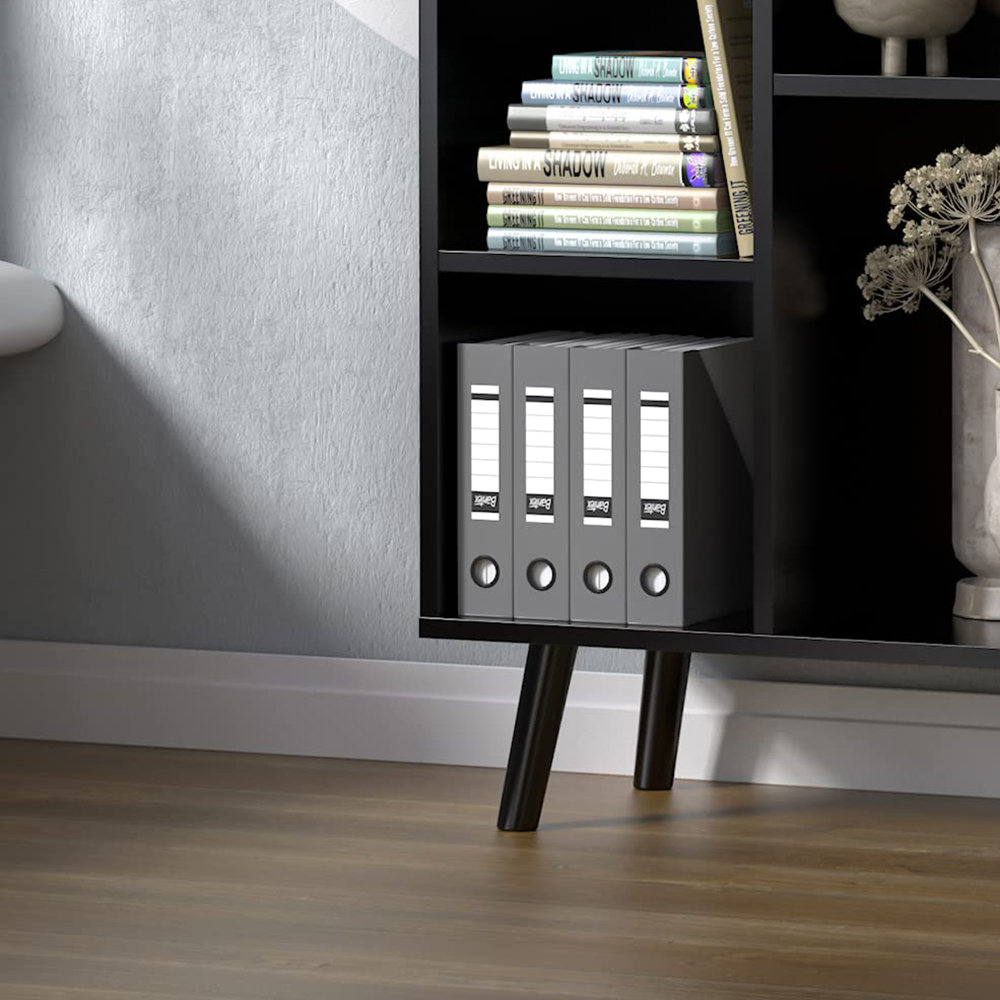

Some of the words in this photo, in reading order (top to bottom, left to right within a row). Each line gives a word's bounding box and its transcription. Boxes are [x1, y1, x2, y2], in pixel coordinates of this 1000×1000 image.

[593, 57, 635, 78] SHADOW
[572, 83, 623, 103] SHADOW
[489, 155, 520, 170] LIVING
[522, 157, 533, 170] IN
[534, 158, 541, 171] A
[543, 150, 608, 178] SHADOW
[731, 180, 748, 188] IT
[732, 190, 754, 235] GREENING
